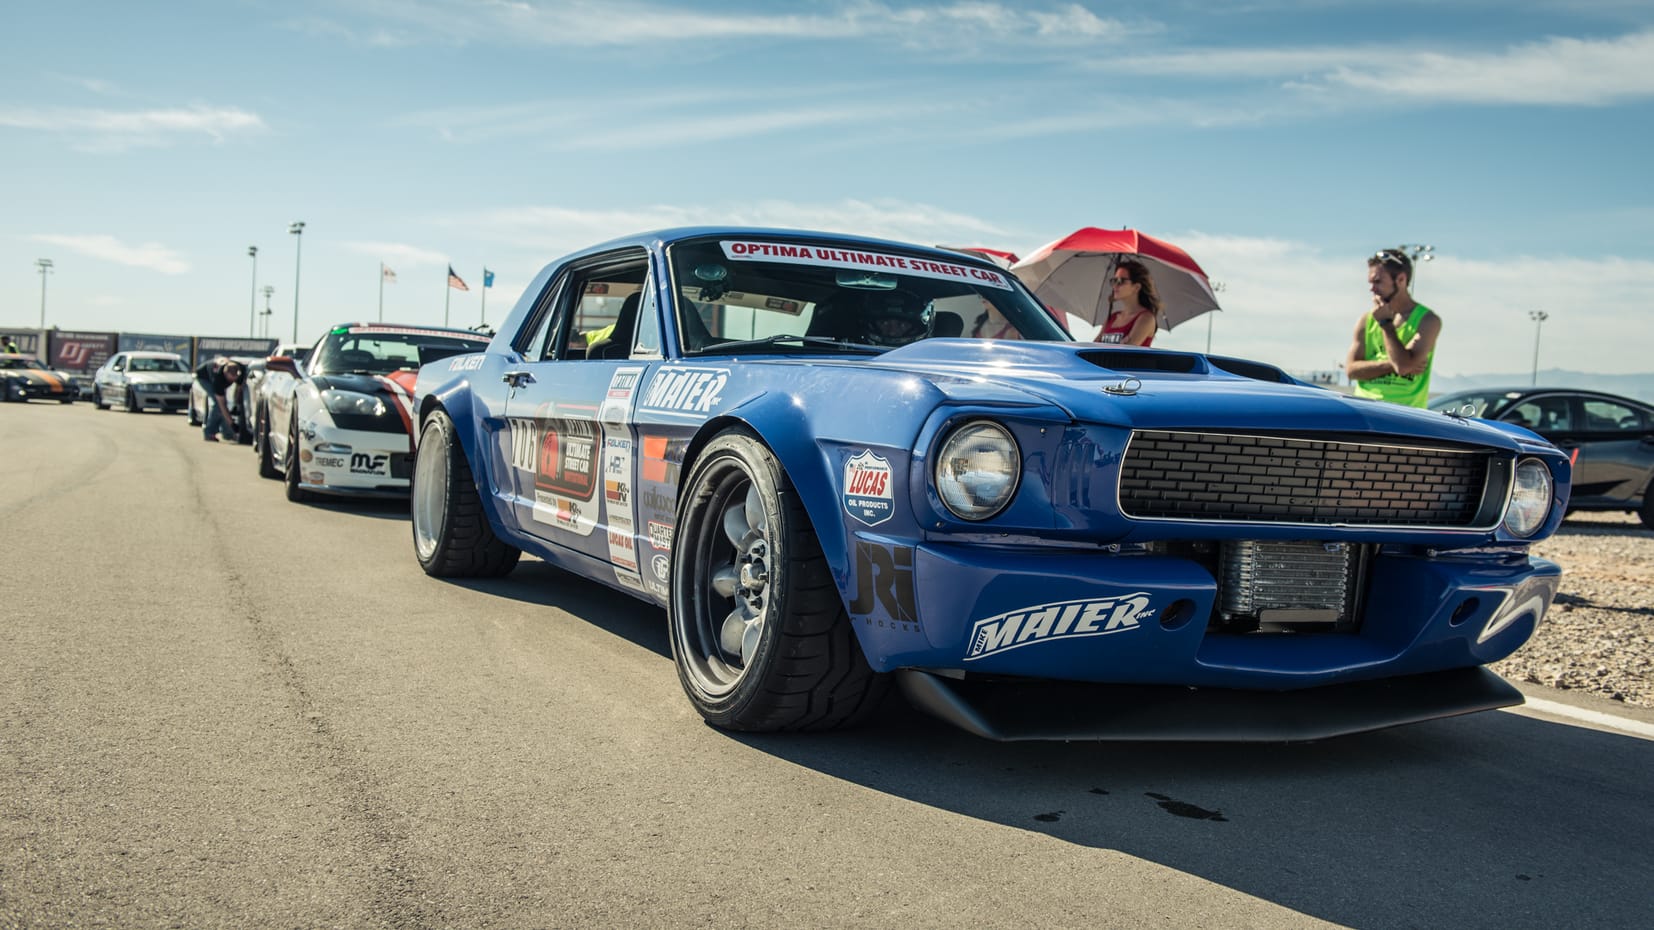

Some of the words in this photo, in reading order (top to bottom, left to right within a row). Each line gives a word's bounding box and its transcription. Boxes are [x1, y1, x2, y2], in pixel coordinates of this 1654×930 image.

[731, 243, 813, 259] OPTIMA
[816, 249, 908, 269] ULTIMATE
[909, 259, 968, 277] STREET
[969, 269, 1002, 284] CAR
[448, 355, 486, 371] FALKEN
[645, 371, 727, 412] MAIER
[565, 442, 591, 460] ULTIMATE
[607, 438, 631, 448] FALKEN
[315, 456, 345, 468] TREMEC
[849, 470, 889, 496] LUCAS
[848, 499, 858, 507] OIL
[858, 500, 889, 510] PRODUCTS
[648, 522, 674, 539] QUARTE
[974, 628, 988, 653] MIKE
[985, 596, 1149, 652] MAIER
